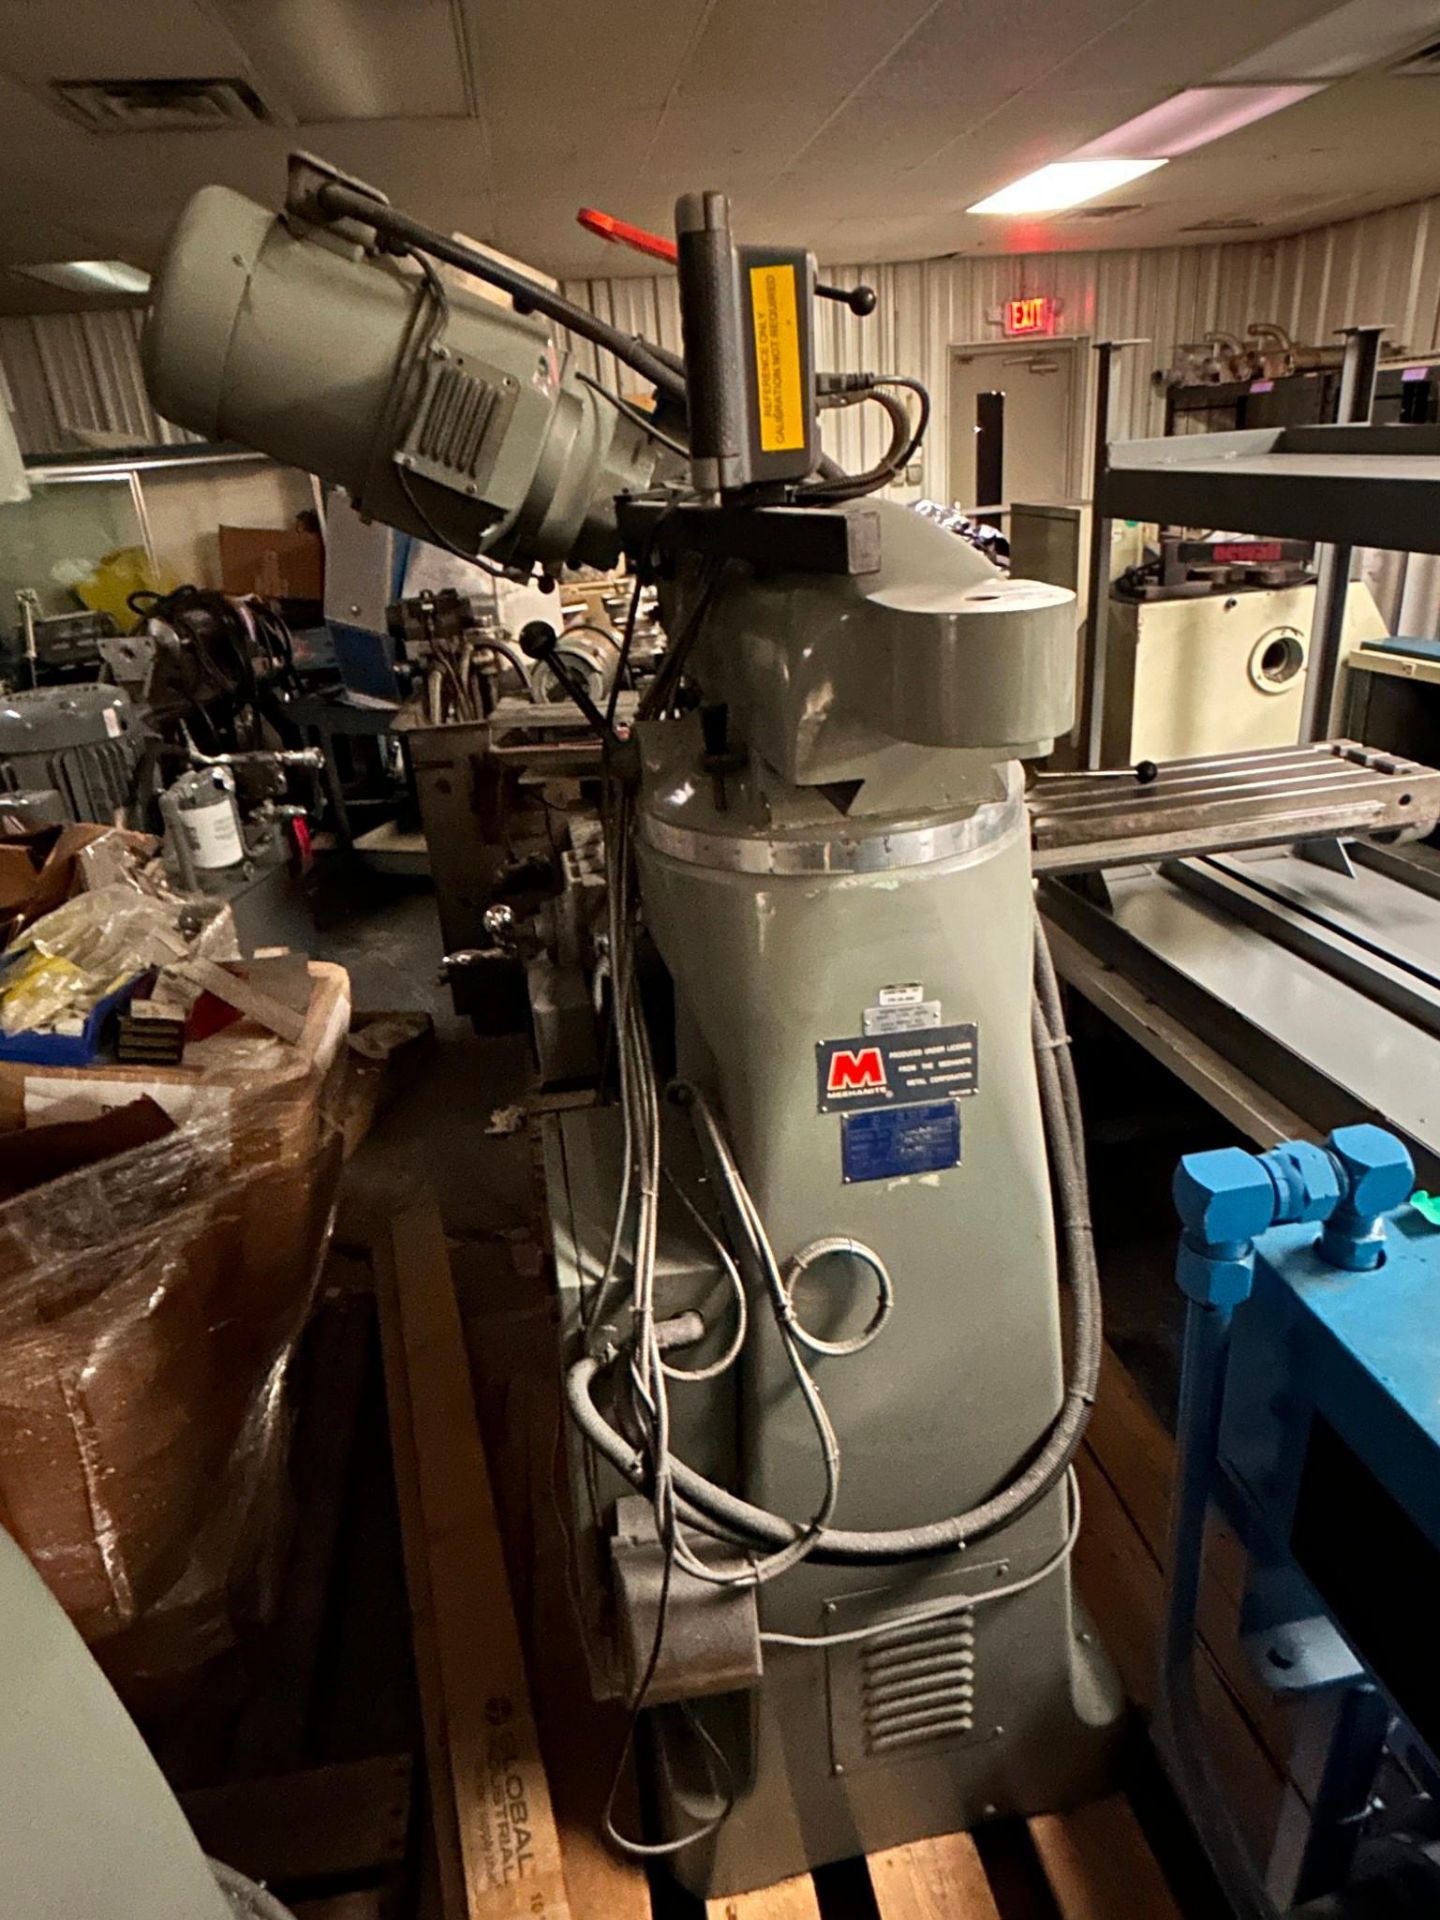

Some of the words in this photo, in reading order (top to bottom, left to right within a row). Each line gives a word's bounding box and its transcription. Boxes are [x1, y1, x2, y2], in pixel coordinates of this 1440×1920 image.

[766, 274, 779, 337] REQUIRED
[1012, 298, 1043, 329] EXIT
[758, 312, 769, 344] ONLY
[770, 341, 780, 365] NOT
[760, 348, 773, 417] REFERENCE
[772, 368, 785, 444] CALIBRATION
[827, 1047, 887, 1090] M
